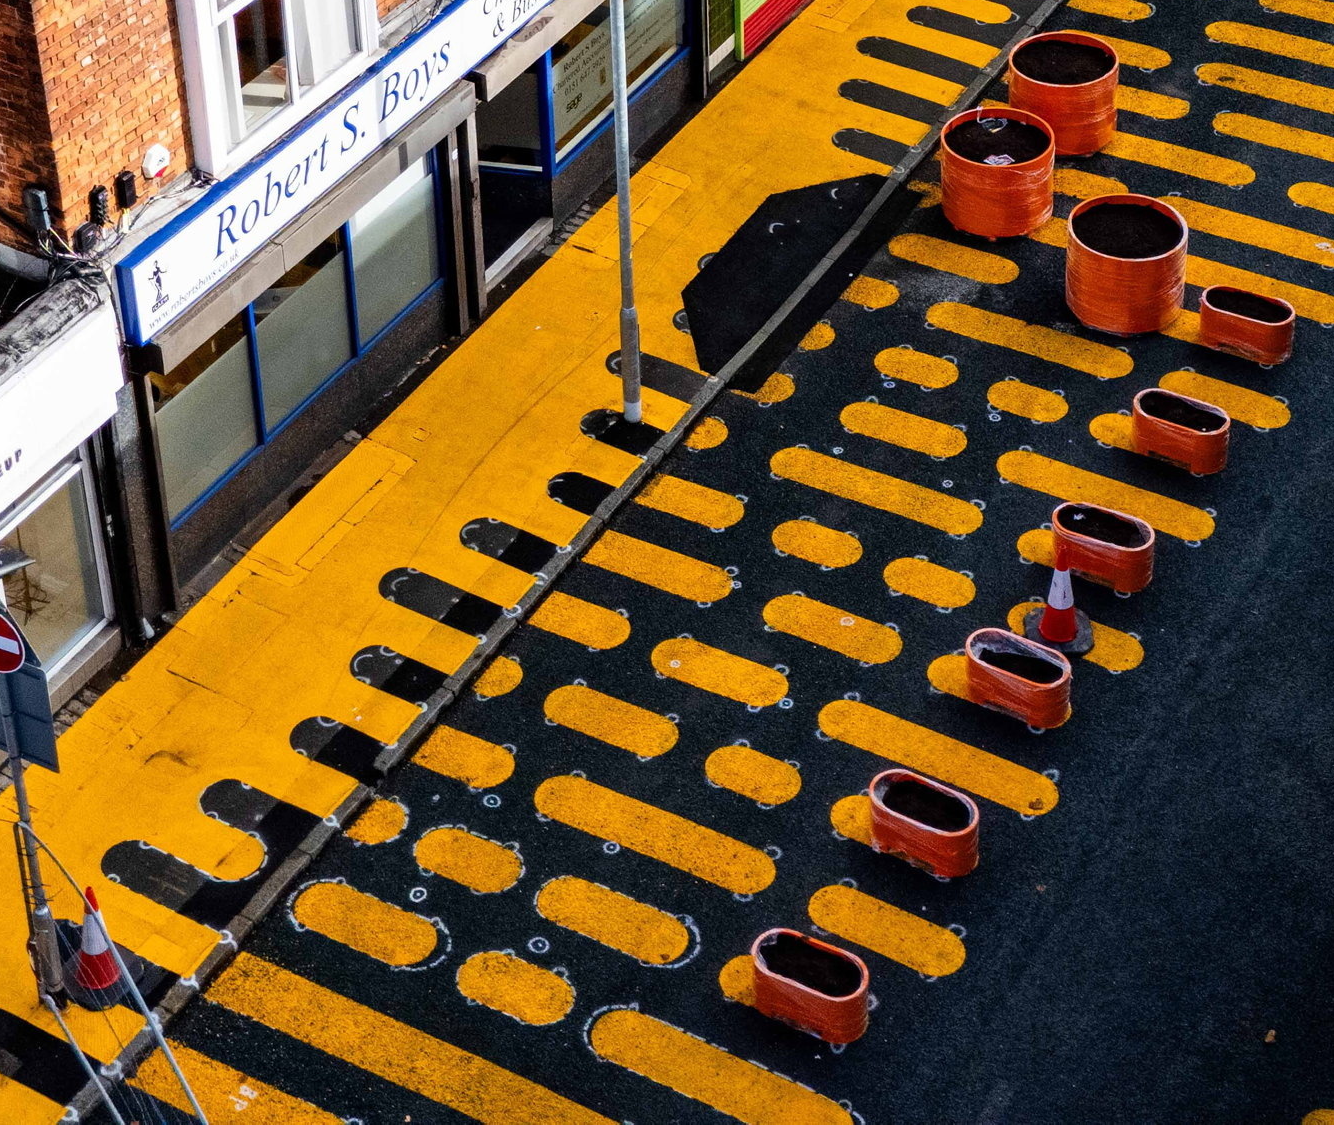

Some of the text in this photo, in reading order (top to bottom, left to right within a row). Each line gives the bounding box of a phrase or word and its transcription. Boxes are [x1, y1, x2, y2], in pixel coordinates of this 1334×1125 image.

[492, 11, 505, 38] &
[565, 92, 583, 113] sage
[213, 39, 451, 261] Robert S. Boys
